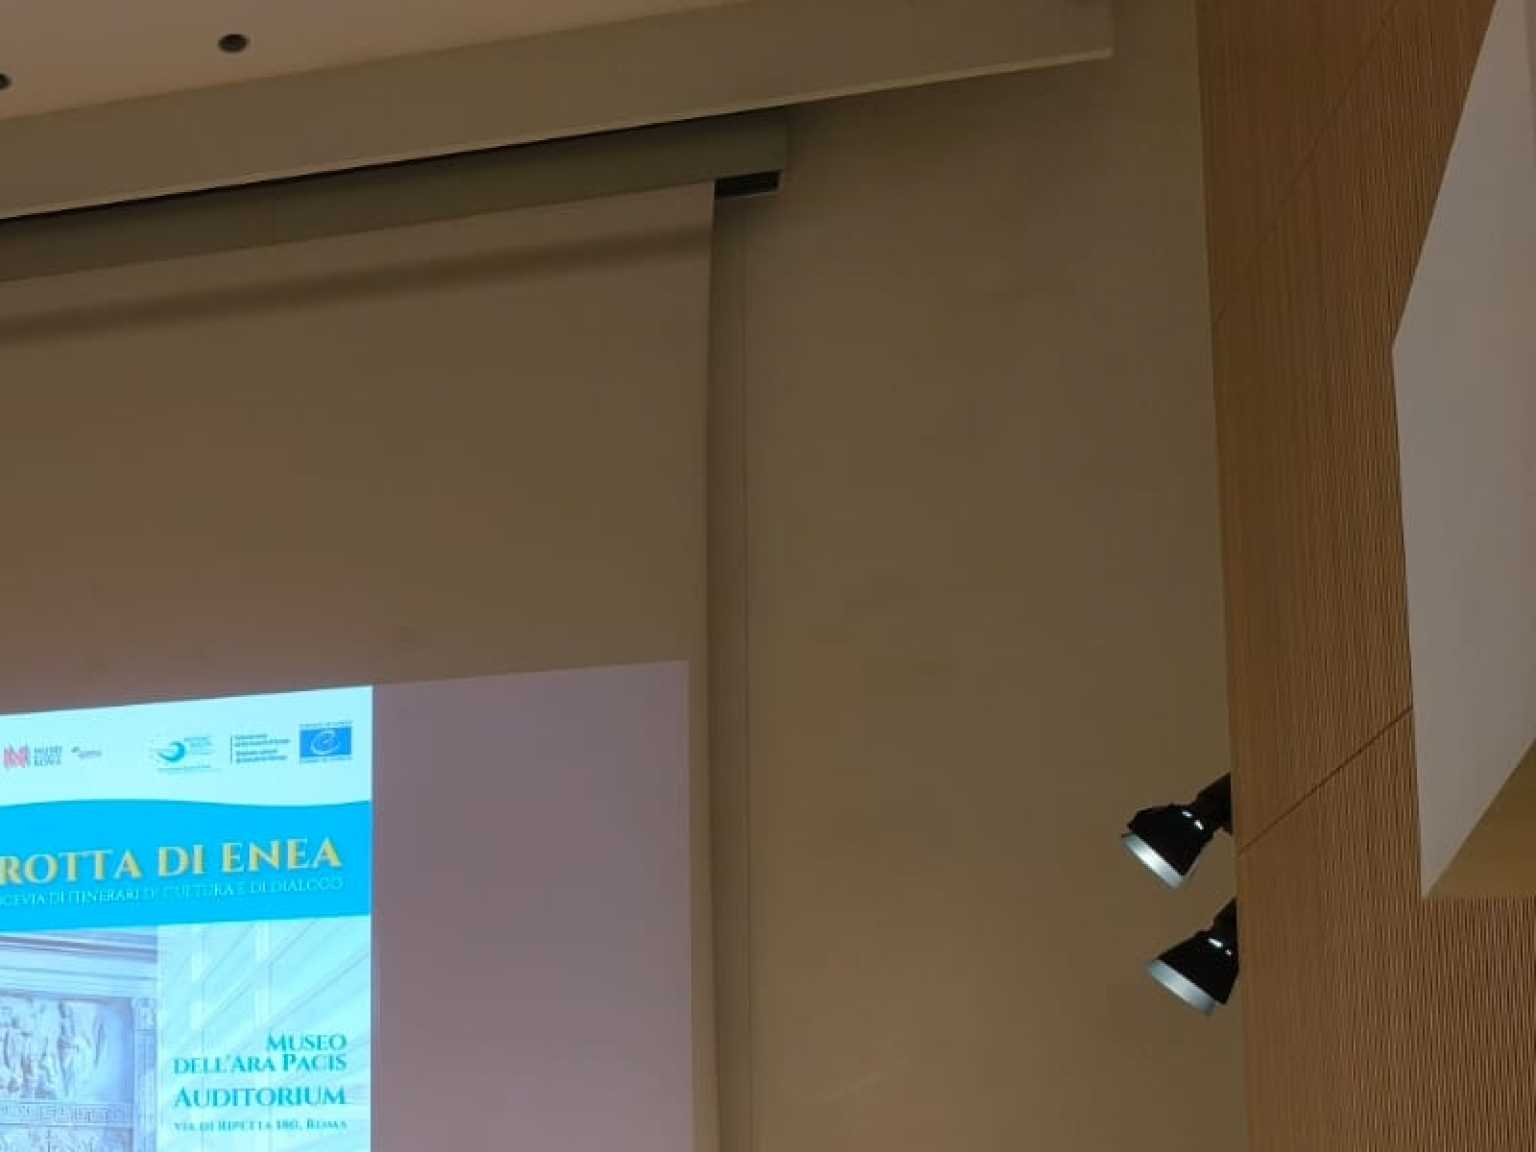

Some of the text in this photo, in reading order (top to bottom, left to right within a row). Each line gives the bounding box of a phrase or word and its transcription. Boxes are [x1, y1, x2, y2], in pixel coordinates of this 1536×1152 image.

[157, 843, 204, 877] DI
[221, 837, 343, 873] ENEA
[266, 1032, 347, 1052] MUSEO
[174, 1053, 347, 1075] DELL'ARA PACIS
[174, 1086, 347, 1107] AUDITORIUM
